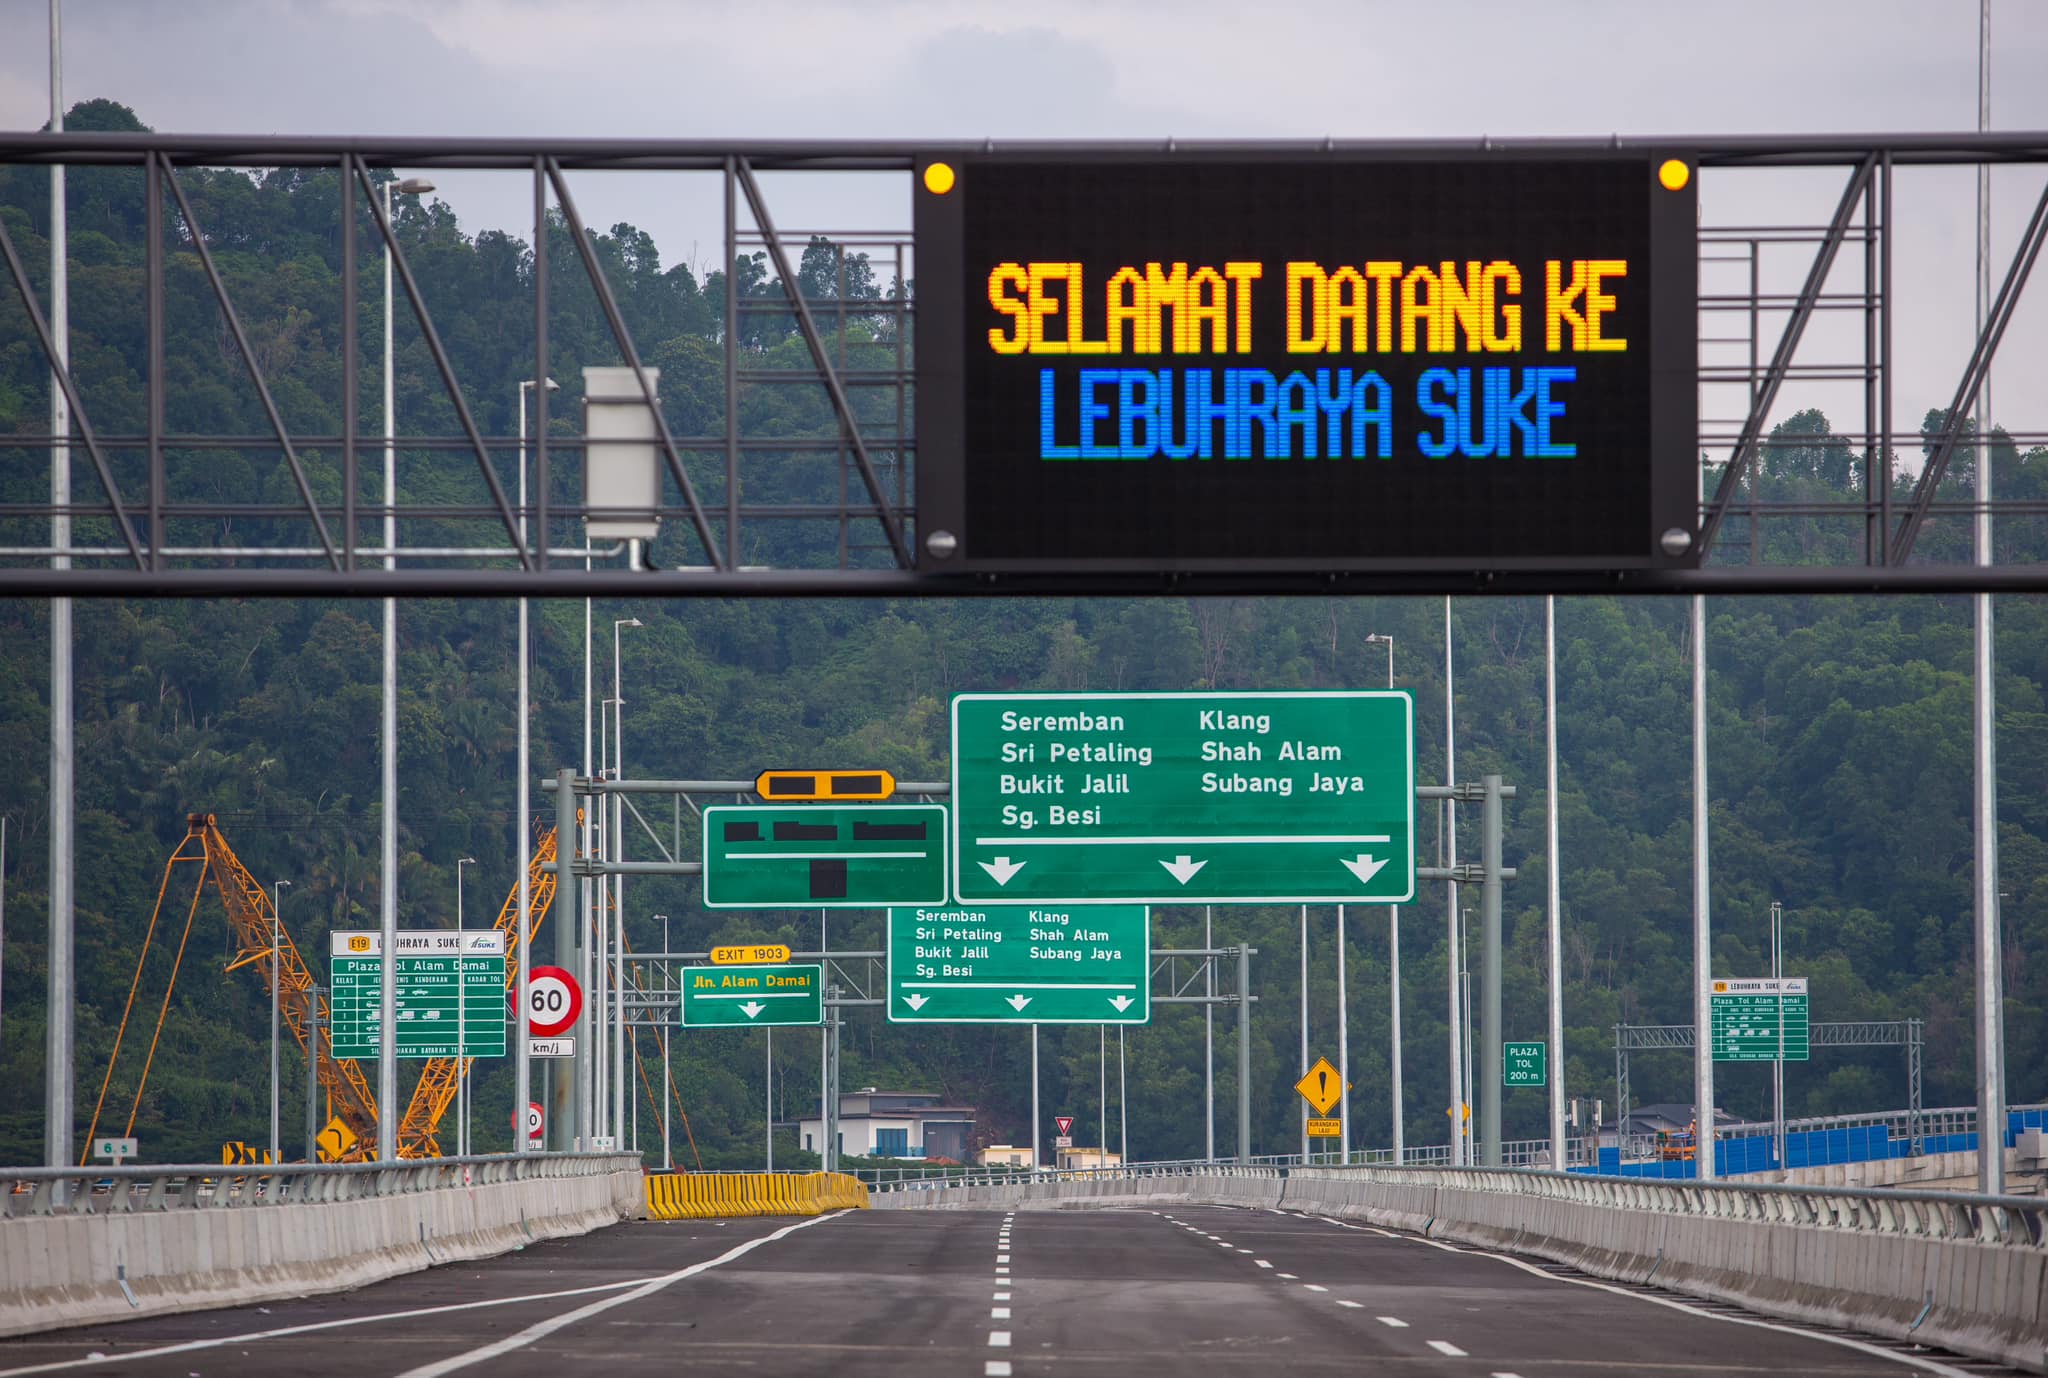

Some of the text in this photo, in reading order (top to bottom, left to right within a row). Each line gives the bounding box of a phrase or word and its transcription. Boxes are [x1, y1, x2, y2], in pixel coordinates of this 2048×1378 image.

[988, 260, 1627, 354] SELAMAT DATANG KE
[1040, 366, 1576, 458] LEBUHRAYA SUKE
[1001, 712, 1123, 731] Seremban
[1201, 711, 1269, 733] Klang
[1002, 743, 1151, 766] Sri Petaling
[1202, 742, 1341, 760] Shah Alam
[1001, 774, 1129, 793] Bukit Jalil
[1202, 773, 1363, 796] Subang Jaya
[1002, 806, 1100, 829] Sg. Besi
[917, 910, 985, 921] Seremban
[1030, 911, 1068, 925] Klang
[917, 928, 1001, 942] Sri Petaling
[1031, 929, 1108, 940] Shah Alam
[352, 939, 367, 948] E19
[437, 937, 459, 949] SUKE
[717, 948, 784, 961] EXIT 1903
[916, 946, 988, 958] Bukit Jalil
[1031, 947, 1121, 961] Subang Jaya
[348, 960, 489, 972] Plaza ol Alam Damai
[917, 964, 972, 978] Sg. Besi
[694, 975, 809, 988] Jln. Alam Damai
[531, 990, 562, 1012] 60
[533, 1042, 559, 1054] km/j
[1510, 1048, 1538, 1056] PLAZA
[1516, 1060, 1533, 1068] TOL
[1510, 1072, 1528, 1080] 200
[530, 1114, 537, 1126] 0
